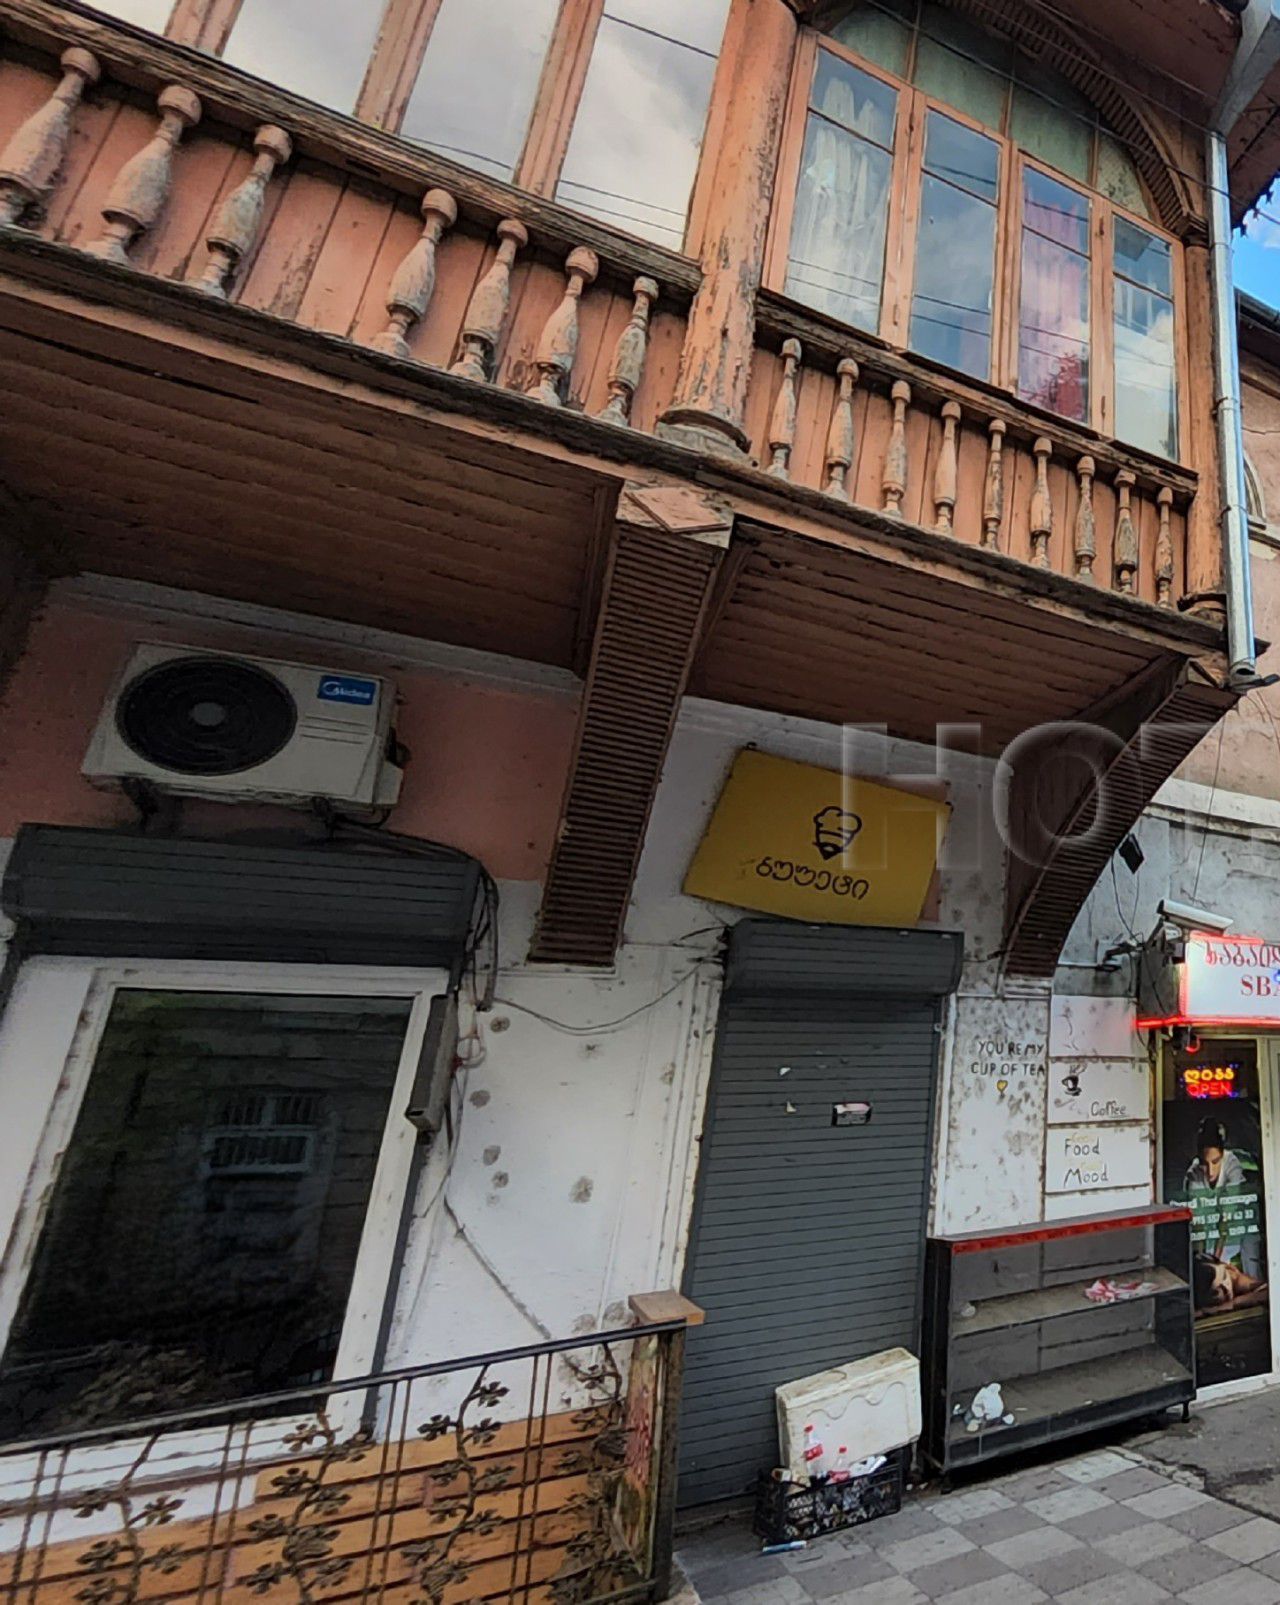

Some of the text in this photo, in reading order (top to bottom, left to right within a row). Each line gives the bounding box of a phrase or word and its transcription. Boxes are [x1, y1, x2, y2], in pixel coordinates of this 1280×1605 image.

[755, 856, 869, 900] ბუფეტი
[1024, 1043, 1044, 1056] MY
[971, 1061, 1045, 1077] CUP OF TEA
[1186, 1082, 1232, 1098] OPEN
[1090, 1100, 1127, 1117] Coffee
[1065, 1136, 1100, 1157] Food
[1063, 1163, 1109, 1189] Mood
